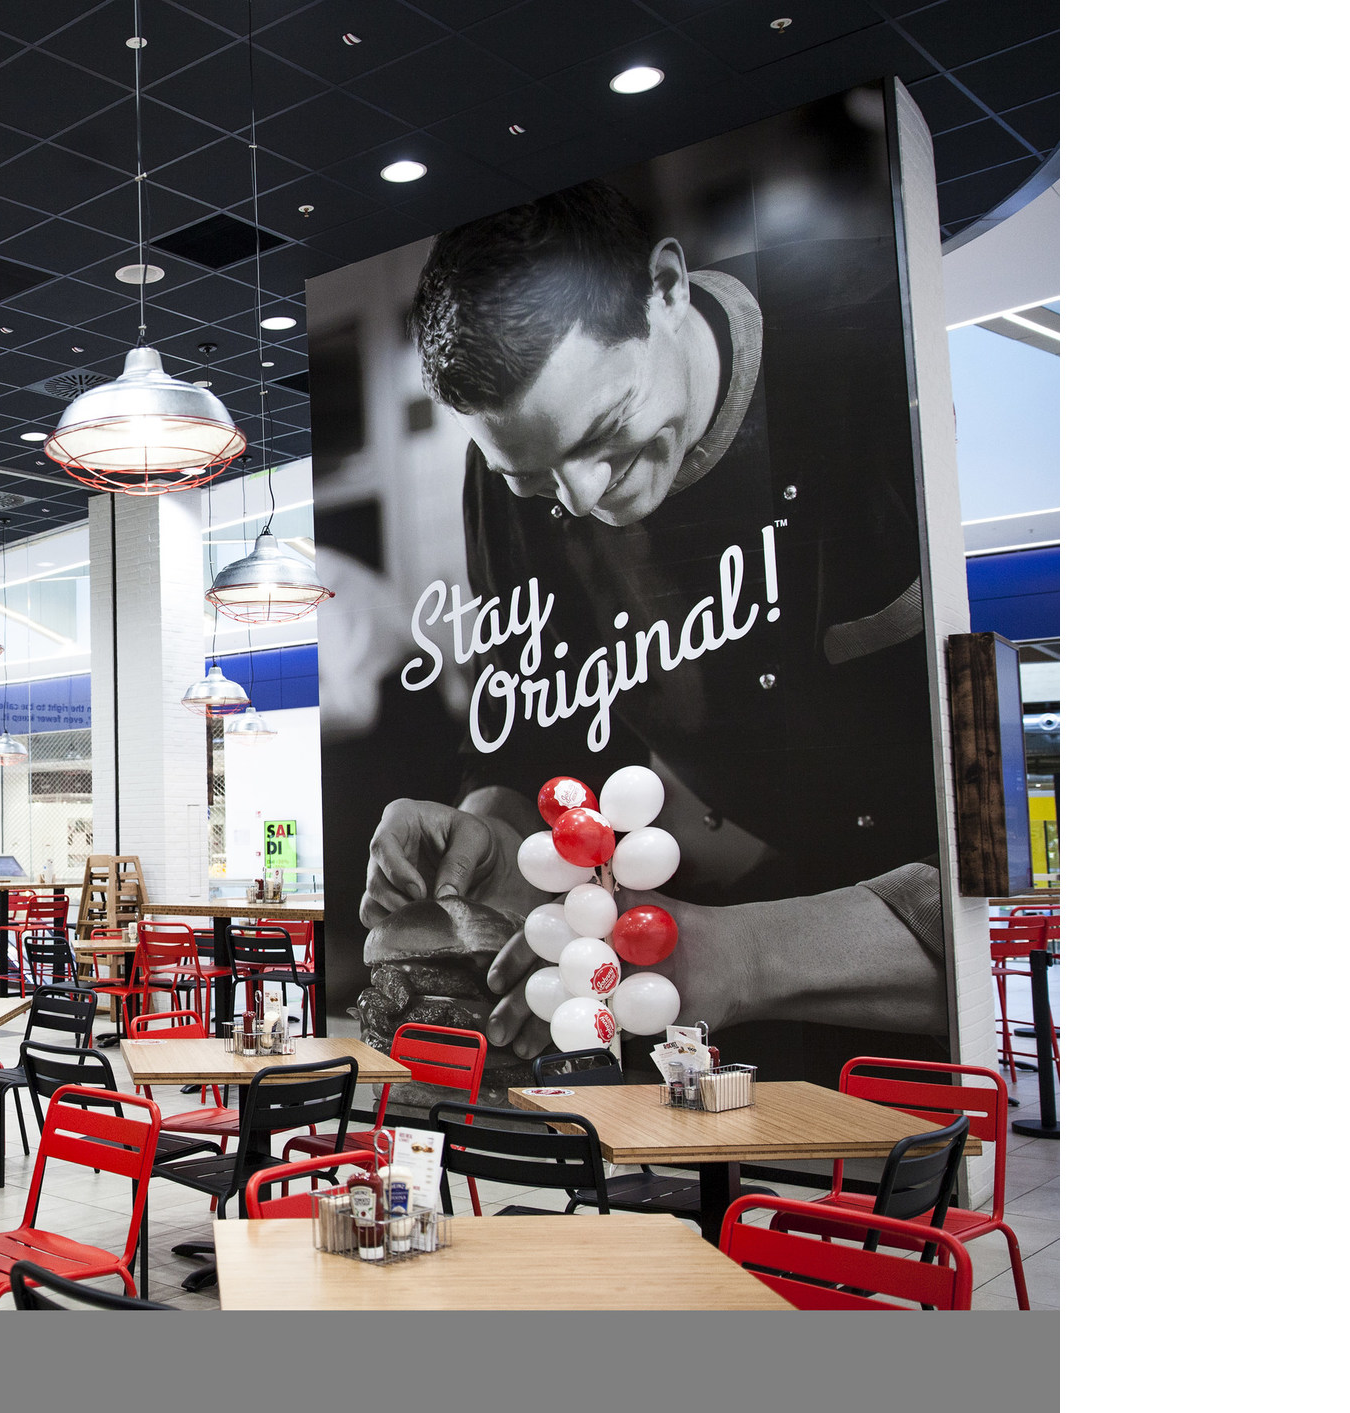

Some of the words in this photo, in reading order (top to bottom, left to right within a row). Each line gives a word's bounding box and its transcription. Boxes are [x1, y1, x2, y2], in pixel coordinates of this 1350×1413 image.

[401, 576, 555, 691] Stay
[469, 525, 781, 753] Original!
[267, 824, 294, 838] SAL
[267, 841, 282, 855] DI
